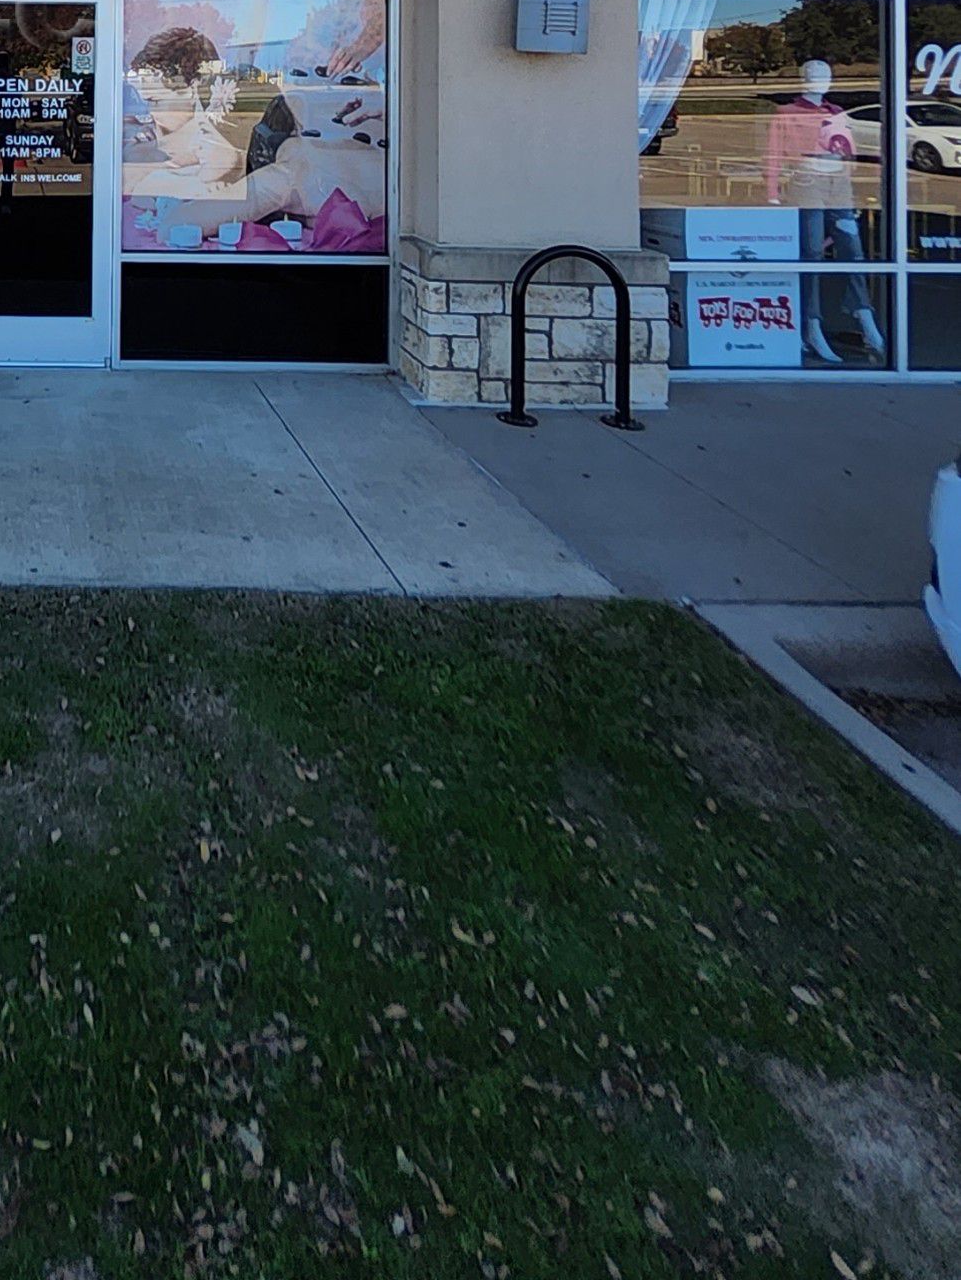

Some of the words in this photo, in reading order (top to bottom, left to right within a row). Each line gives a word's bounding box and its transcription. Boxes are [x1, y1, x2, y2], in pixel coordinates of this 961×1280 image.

[35, 78, 84, 92] DAILY
[1, 98, 29, 108] MON
[41, 98, 66, 108] SAT
[41, 109, 68, 119] 9PM
[5, 135, 54, 146] SUNDAY
[0, 148, 30, 158] 11AM
[20, 174, 36, 183] INS
[37, 174, 83, 183] WELCOME
[700, 301, 728, 317] TOYS
[732, 304, 755, 320] FOR
[762, 306, 789, 320] TOTS
